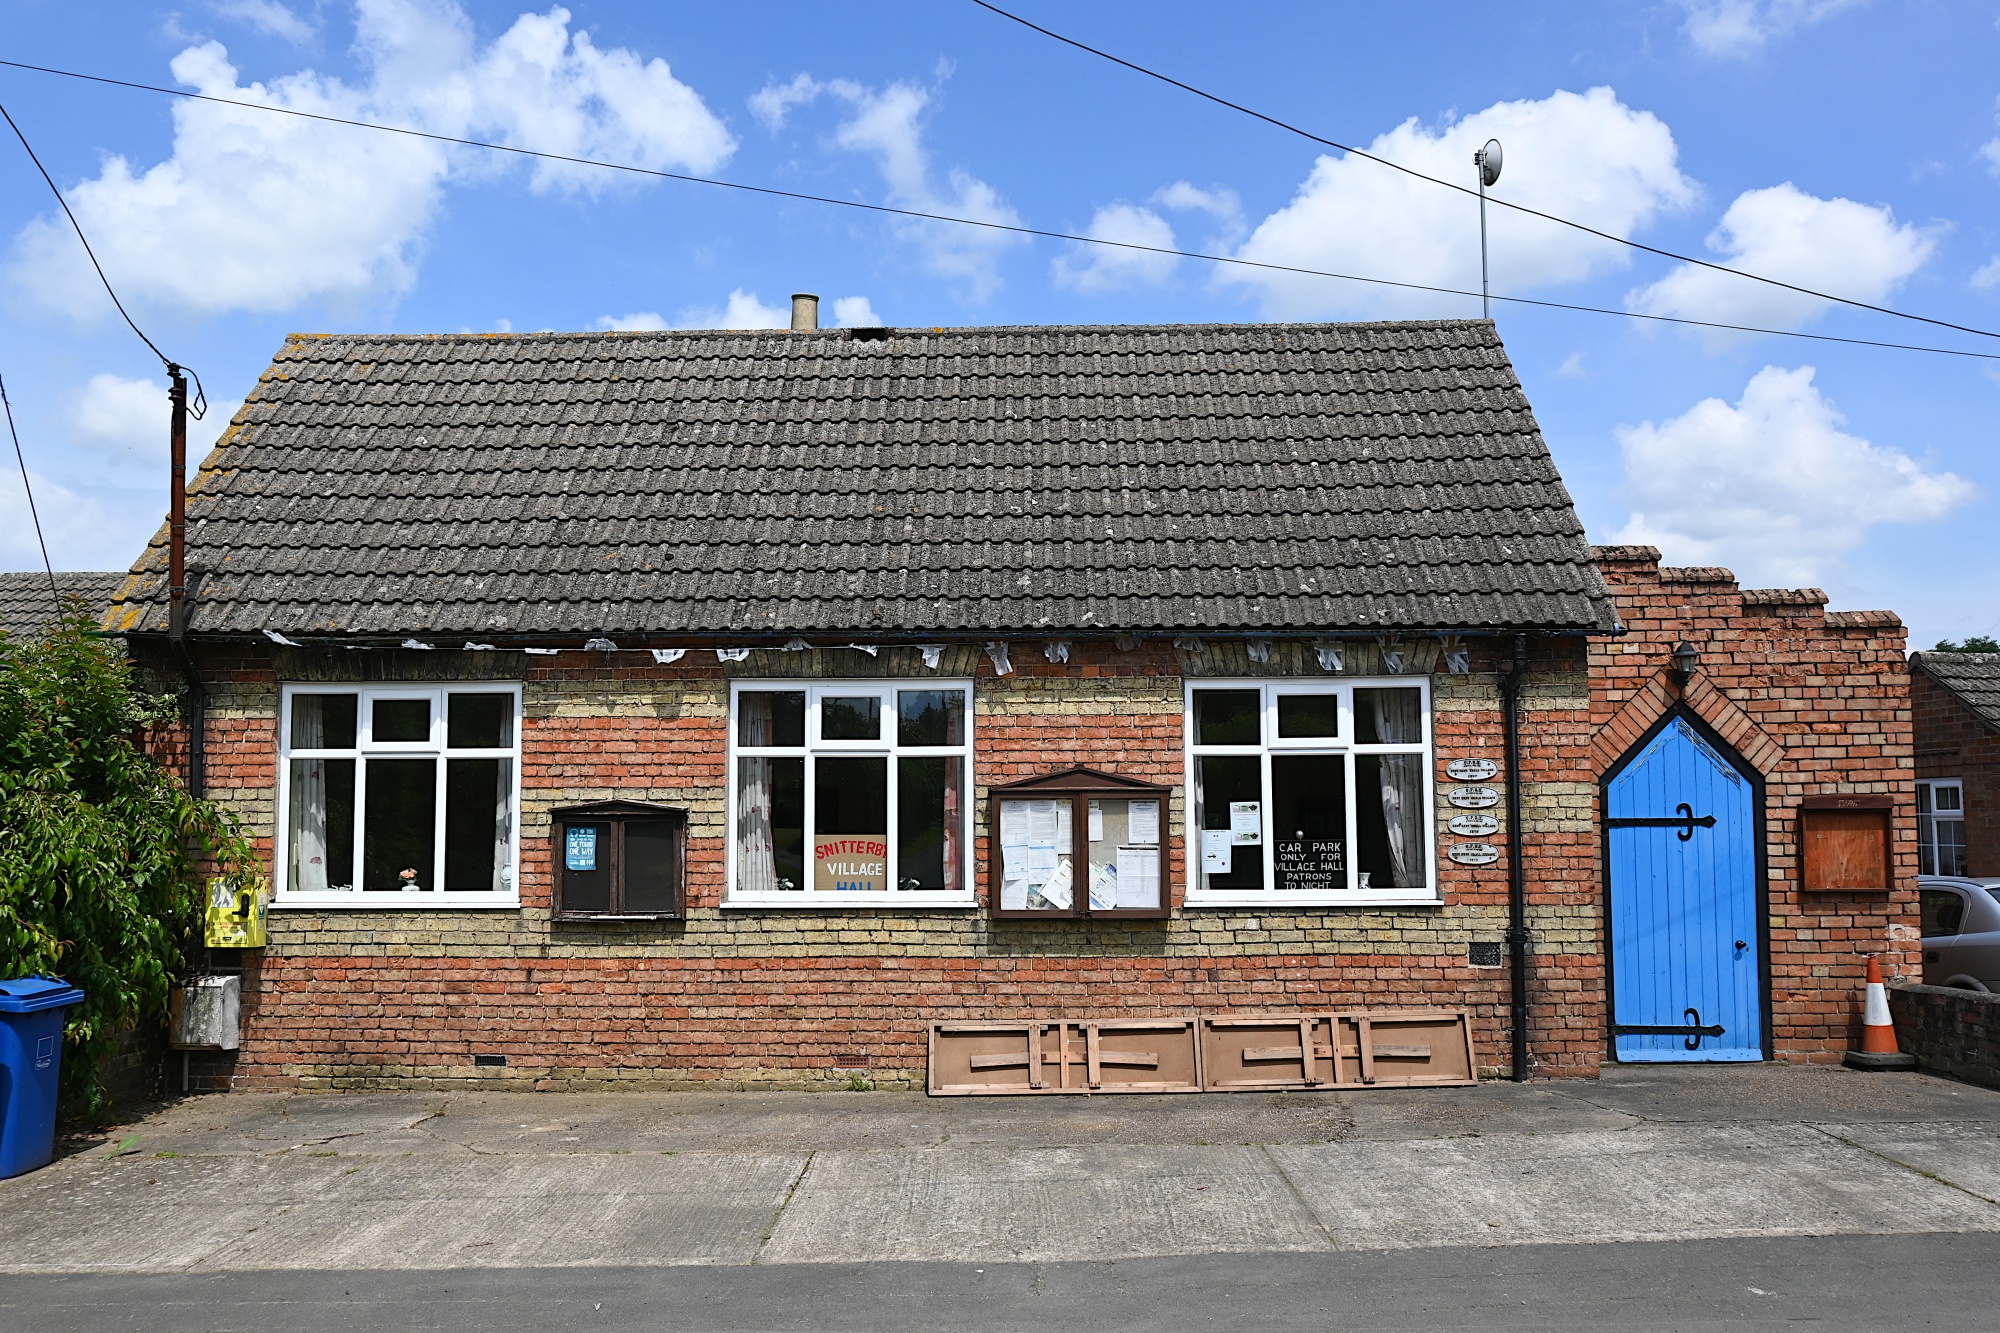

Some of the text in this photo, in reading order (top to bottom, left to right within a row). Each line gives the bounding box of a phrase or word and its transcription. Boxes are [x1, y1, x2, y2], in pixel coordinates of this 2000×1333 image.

[569, 847, 593, 855] ONE WAY
[1279, 842, 1341, 852] CAR PARK
[1280, 853, 1341, 861] ONLY FOR
[826, 862, 883, 876] VILLAGE
[1320, 862, 1344, 871] HALL
[1284, 882, 1297, 890] TO
